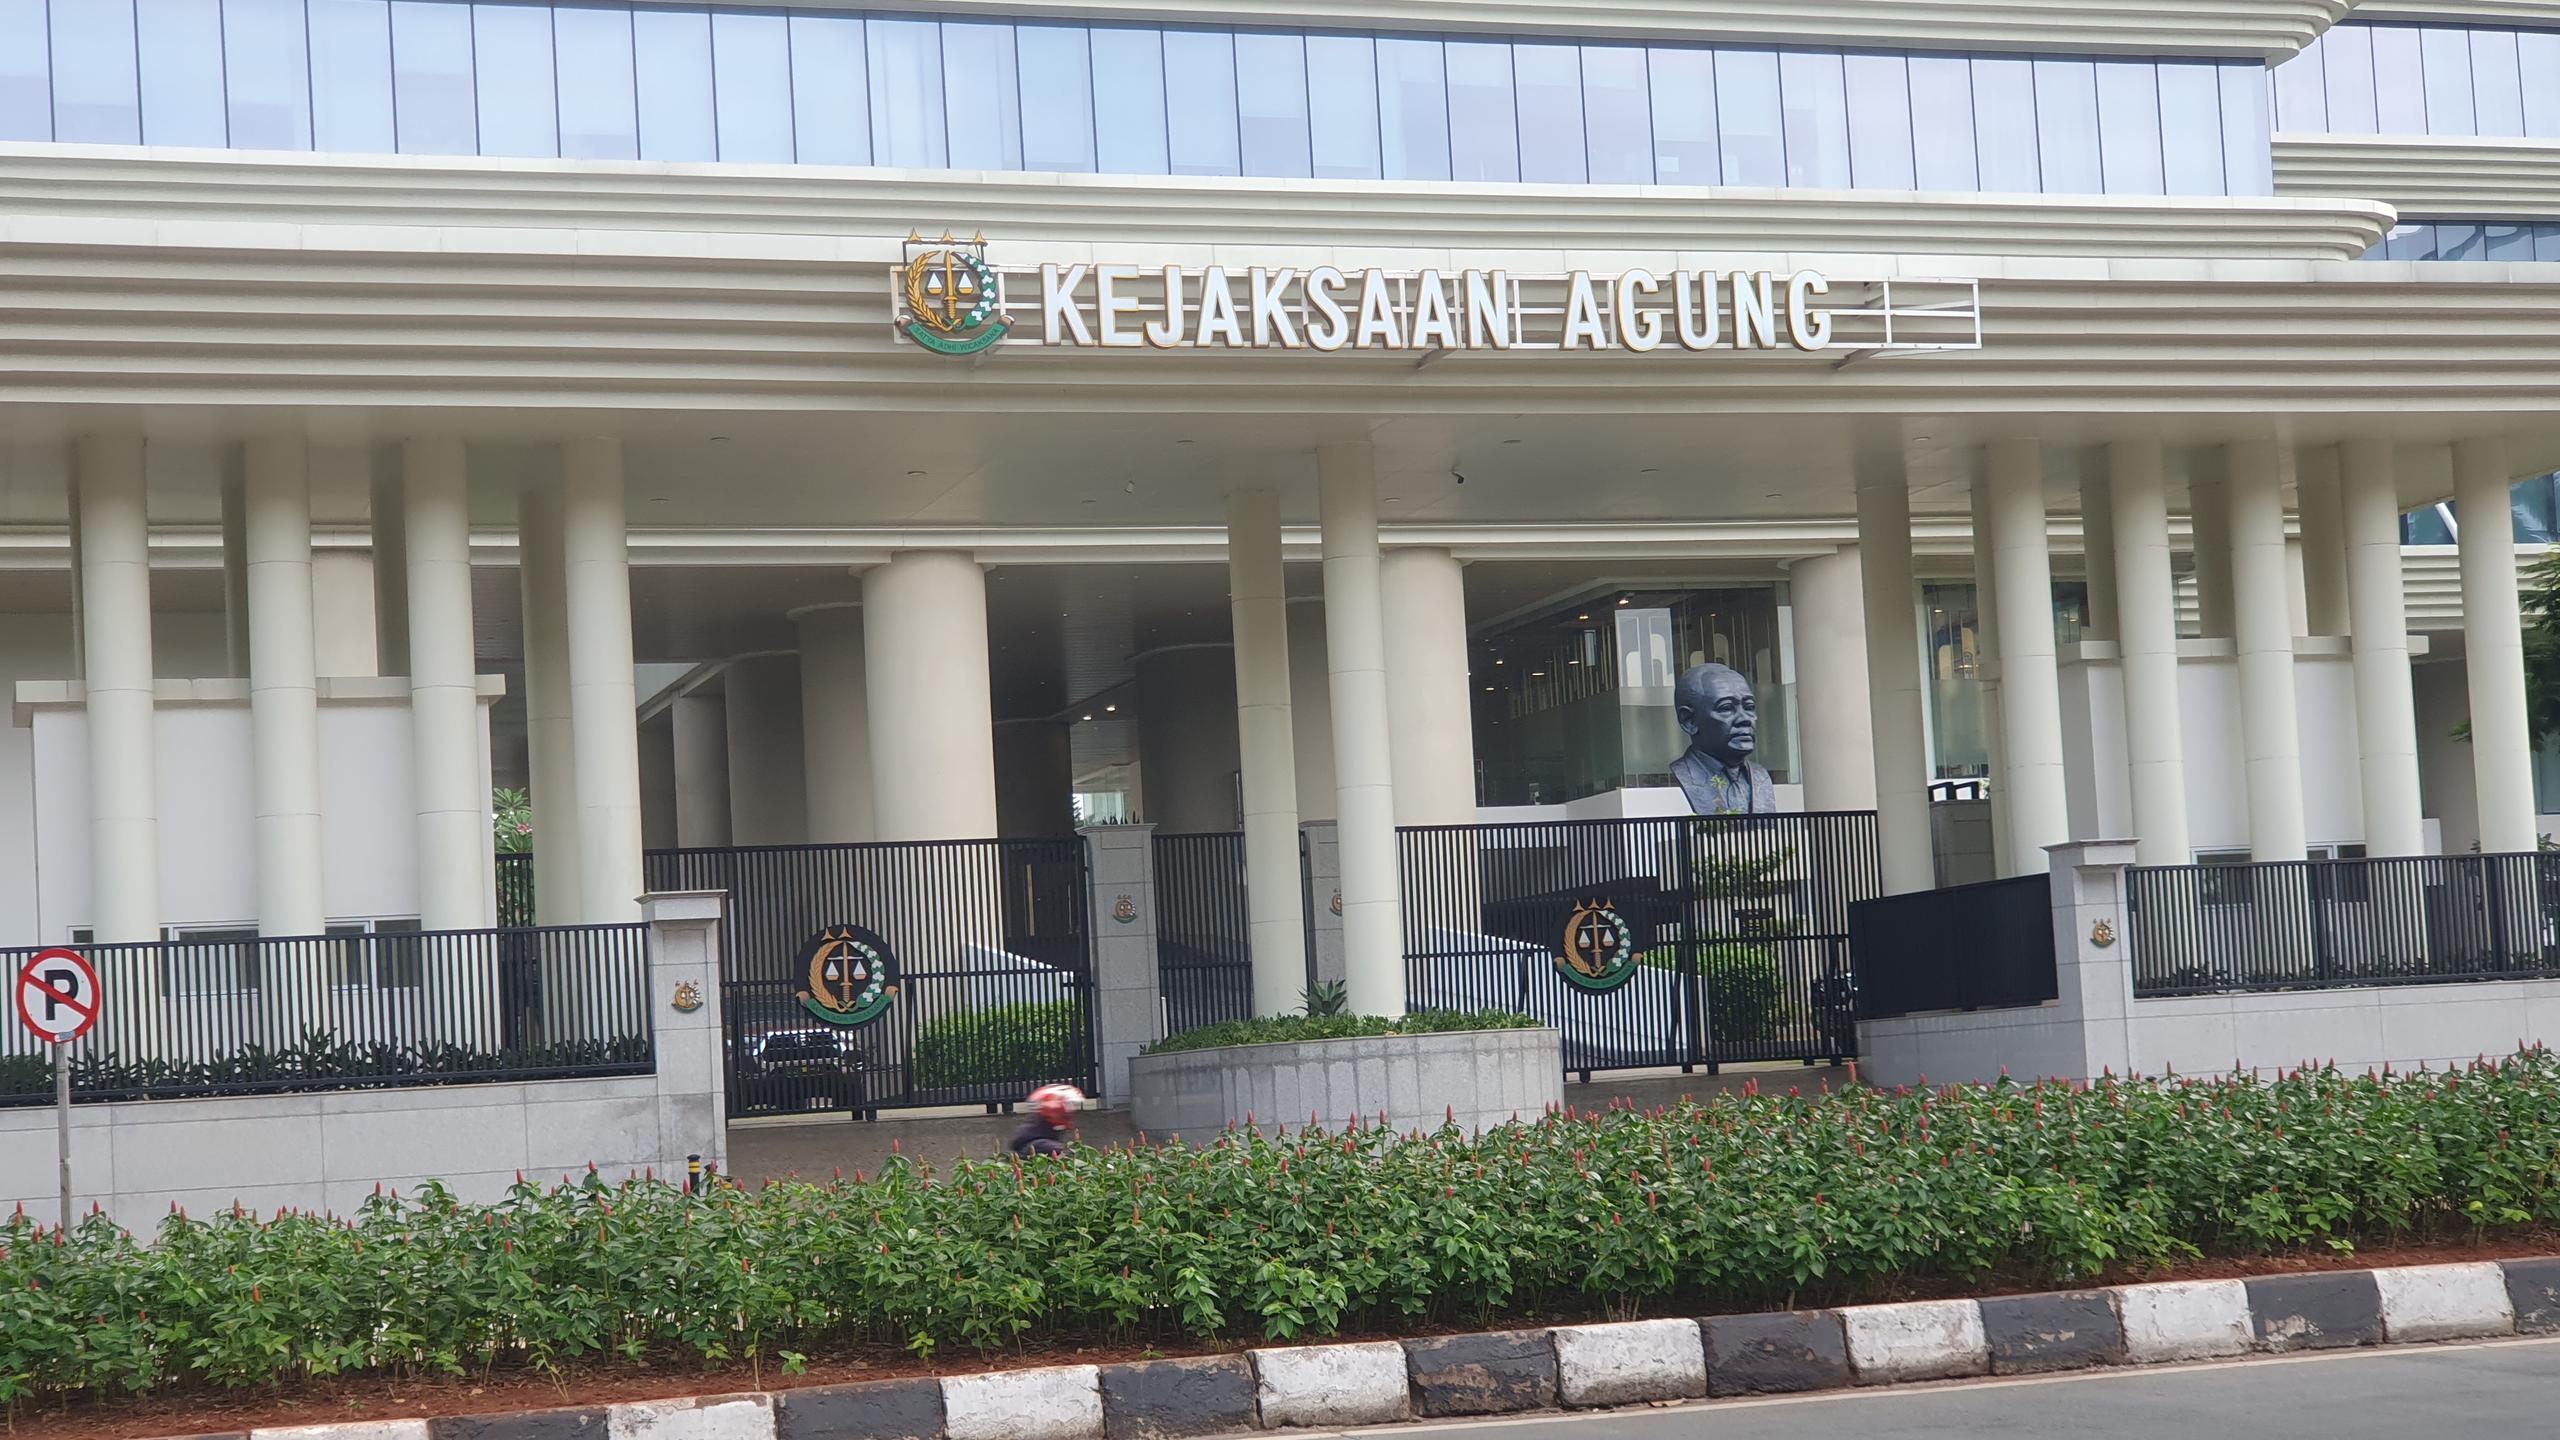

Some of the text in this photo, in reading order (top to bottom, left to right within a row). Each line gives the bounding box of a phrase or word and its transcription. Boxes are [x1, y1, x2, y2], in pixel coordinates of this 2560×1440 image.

[1040, 263, 1832, 353] KEJAKSAAN AGUNG
[45, 970, 78, 1020] P
